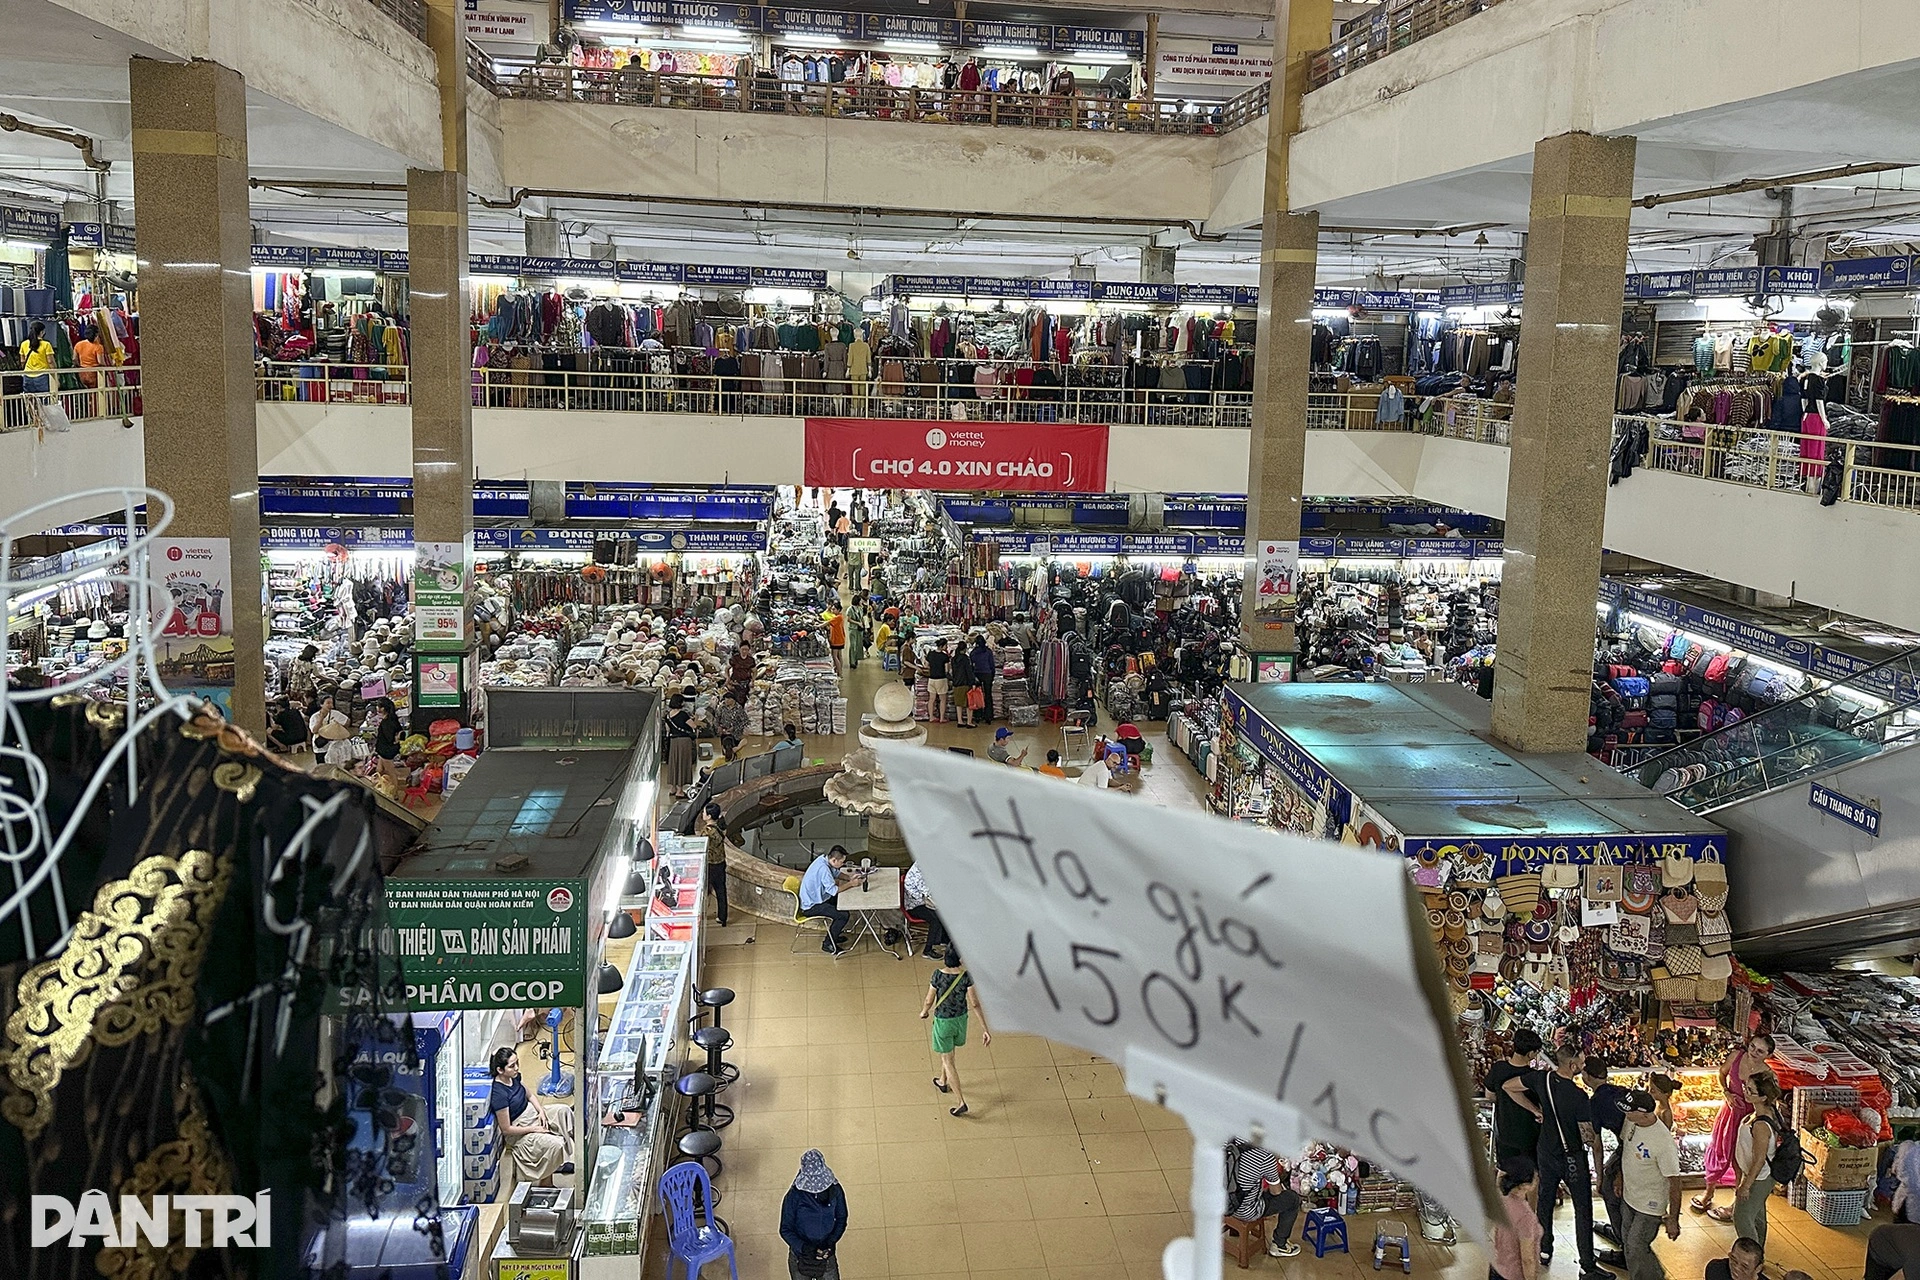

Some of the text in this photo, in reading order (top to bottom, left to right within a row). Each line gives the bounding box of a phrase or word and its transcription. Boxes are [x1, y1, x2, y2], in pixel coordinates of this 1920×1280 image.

[632, 1, 667, 14] VINH
[815, 13, 843, 27] QUANG
[1075, 28, 1124, 44] PHÚC LAN
[1162, 54, 1177, 62] CÔNG
[652, 264, 667, 272] ANH
[697, 266, 734, 275] LAN ANH
[764, 269, 812, 278] LAN ANH
[1786, 270, 1813, 281] KHÔI
[1134, 287, 1158, 297] LOAN
[949, 430, 984, 440] viettel
[949, 439, 986, 449] money
[870, 456, 1053, 480] CHỢ 4.0 XIN CHÀO
[299, 528, 321, 538] HOA
[688, 532, 748, 542] THÀNH PHÚC
[865, 539, 878, 547] RA
[1134, 536, 1175, 544] NAM OANH
[185, 554, 214, 562] money
[165, 569, 202, 582] XIN CHÀO
[437, 617, 458, 629] 95%
[1702, 613, 1736, 632] QUANG
[1260, 724, 1286, 756] DONG
[1287, 747, 1315, 781] XUAN
[1266, 745, 1322, 799] Souvenirs Sho
[1812, 789, 1876, 830] CẦU THANG SỐ 10
[1521, 861, 1544, 873] So
[396, 890, 414, 898] BAN
[415, 888, 440, 898] NHÂN
[442, 888, 460, 898] DÂN
[462, 888, 490, 898] THÀNH
[491, 887, 510, 898] PHỐ
[511, 888, 523, 897] HÀ
[524, 888, 541, 899] NỘI
[388, 897, 534, 910] ỦY BAN NHÂN DÂN QUẬN HOÀN KIẾM
[398, 924, 436, 962] THIỆU
[445, 933, 463, 949] VÀ
[470, 921, 499, 955] BÁN
[501, 919, 530, 955] SẢN
[532, 915, 571, 955] PHẨM
[405, 977, 565, 1006] PHẨM OCOP
